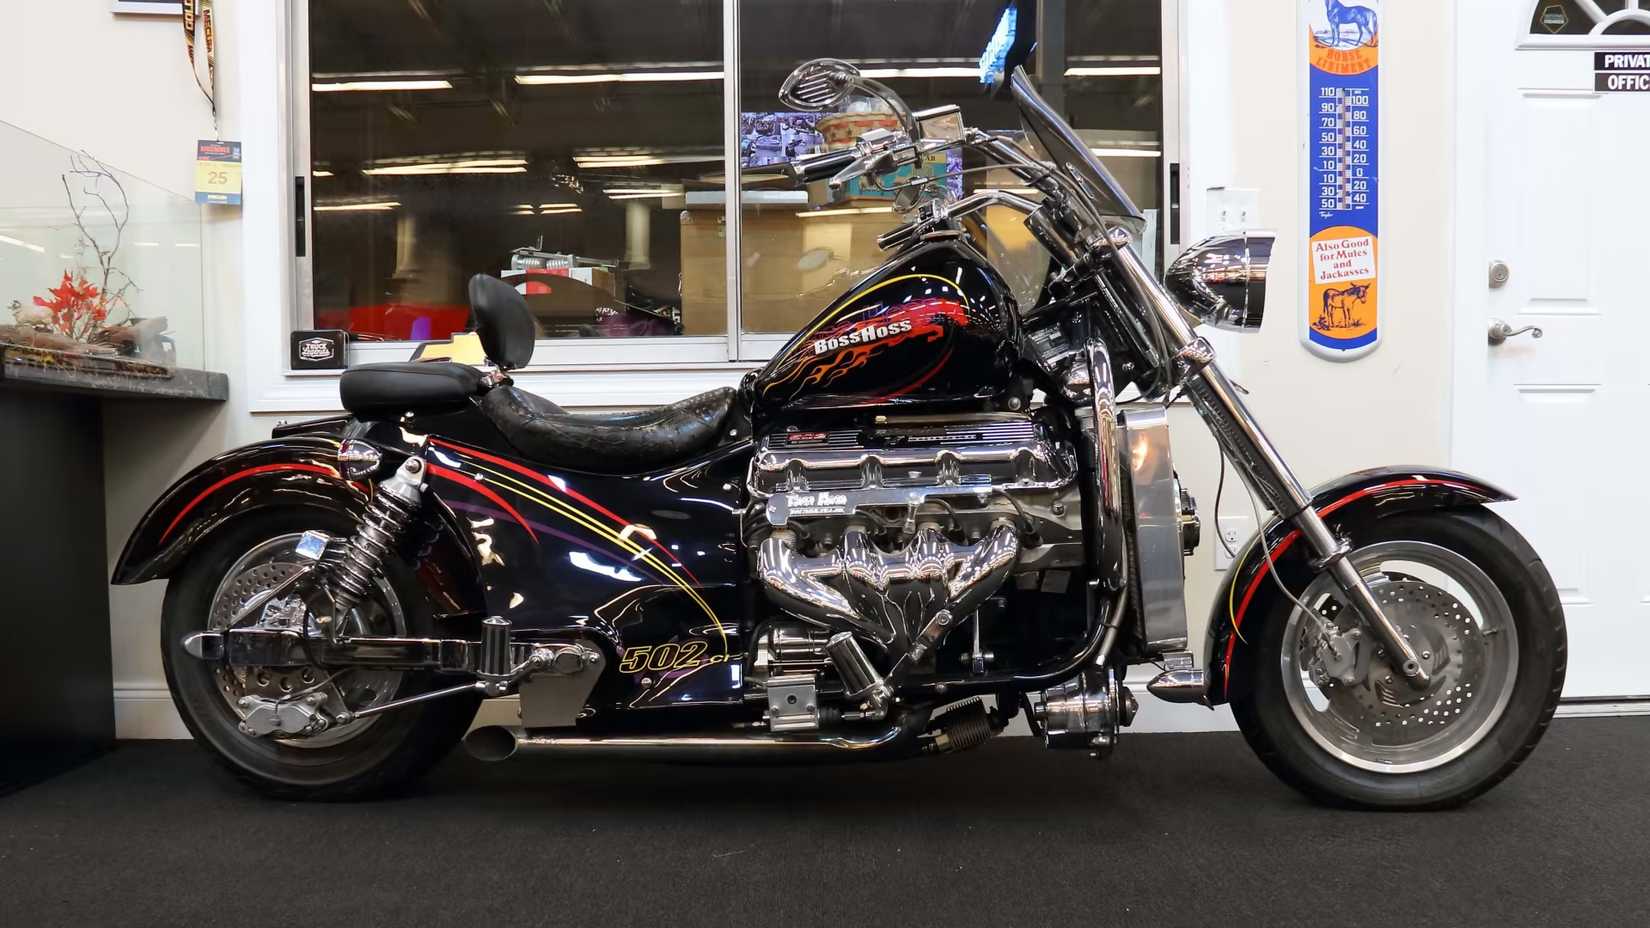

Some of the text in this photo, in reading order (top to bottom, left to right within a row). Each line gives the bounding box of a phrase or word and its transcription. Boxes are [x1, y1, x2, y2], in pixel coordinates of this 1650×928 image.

[1604, 54, 1650, 68] PRIVAT
[1607, 74, 1650, 90] OFFIC
[1321, 87, 1335, 96] 110
[1352, 95, 1369, 105] 100
[1321, 103, 1335, 112] 90
[1353, 110, 1367, 120] 80
[1321, 118, 1335, 126] 70
[1353, 126, 1367, 135] 60
[1321, 132, 1335, 142] 50
[1353, 140, 1367, 149] 40
[1321, 146, 1335, 156] 30
[1353, 154, 1367, 163] 20
[1323, 160, 1335, 170] 10
[1356, 168, 1364, 177] 0
[207, 171, 228, 185] 25
[1323, 174, 1335, 183] 10
[1353, 180, 1367, 190] 20
[1321, 186, 1335, 196] 30
[1353, 194, 1367, 202] 40
[1321, 199, 1335, 208] 50
[1316, 239, 1369, 252] Also Good
[1320, 250, 1367, 261] for Mules
[1333, 260, 1352, 269] and
[1320, 267, 1369, 280] Jackasses
[619, 641, 708, 673] 502
